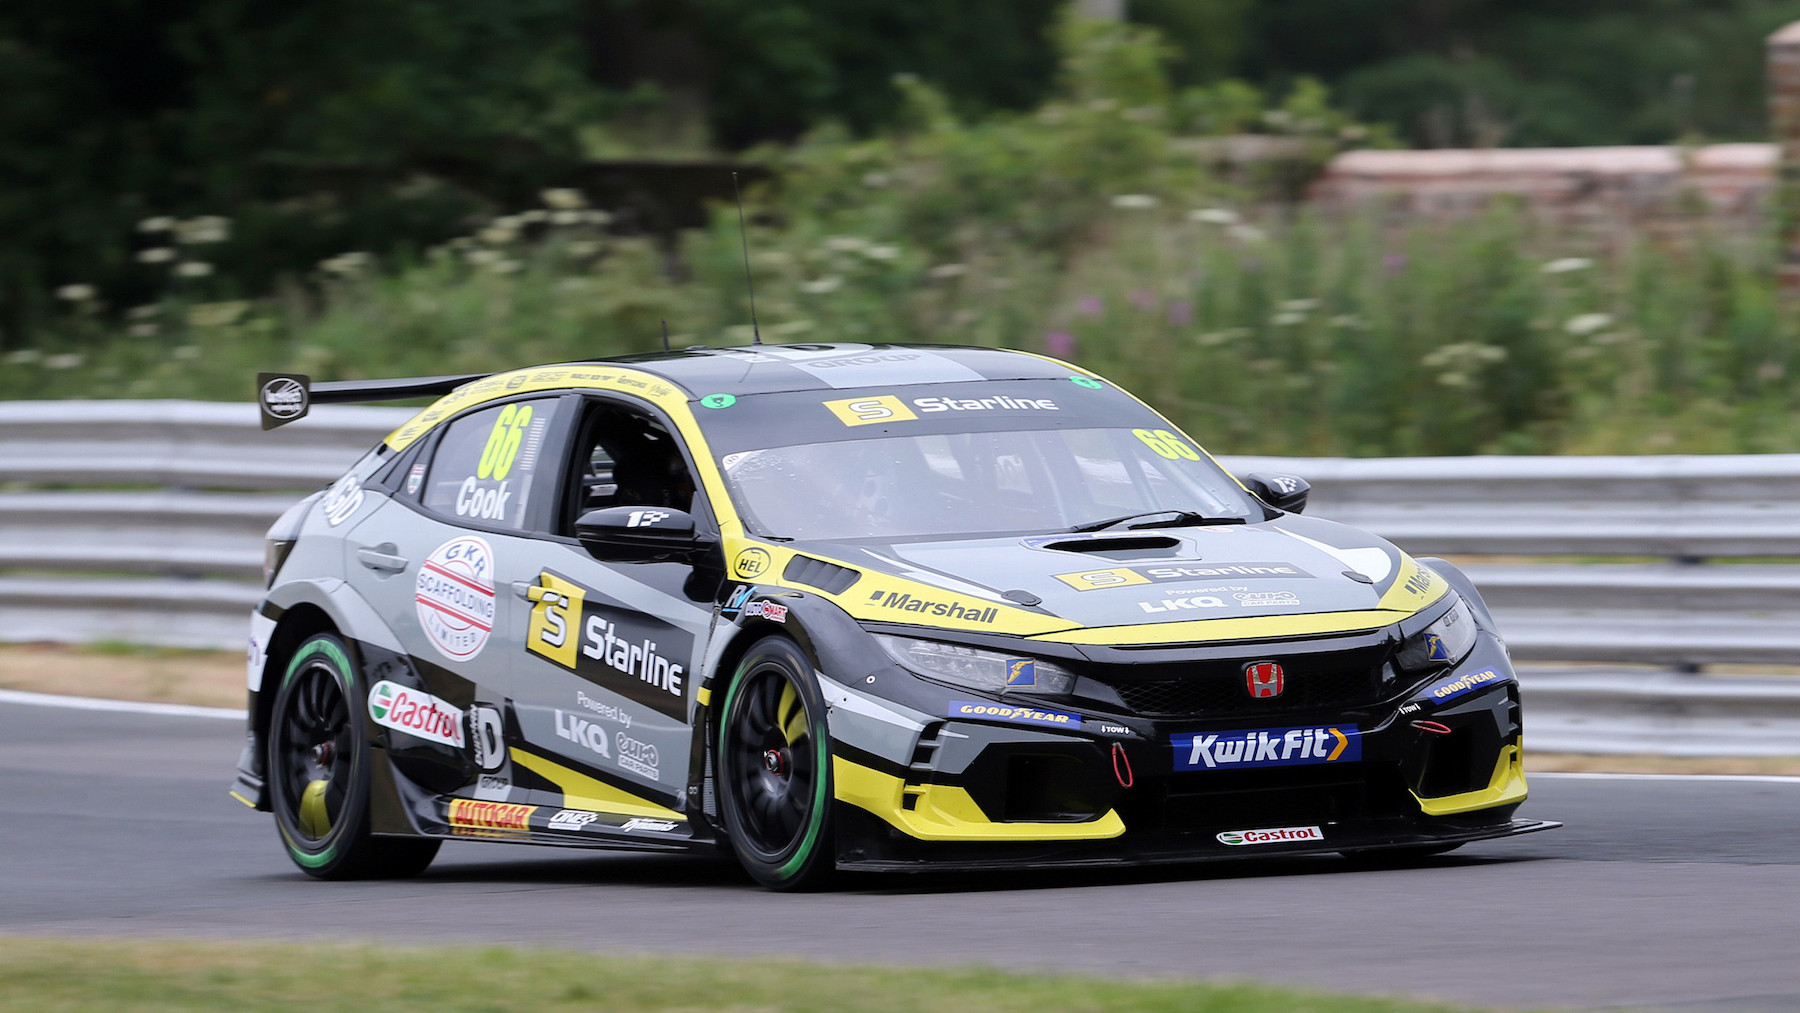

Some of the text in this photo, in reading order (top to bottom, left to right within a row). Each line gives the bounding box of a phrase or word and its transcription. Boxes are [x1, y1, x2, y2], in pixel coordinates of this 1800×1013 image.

[807, 353, 922, 369] GROUP
[913, 395, 1060, 413] Starline
[477, 403, 533, 481] 66
[1131, 428, 1201, 462] 66
[455, 476, 512, 520] Cook
[446, 544, 486, 576] GKR
[738, 558, 761, 573] HEL
[1149, 565, 1297, 579] Starline
[417, 573, 494, 618] SCAFFOLDING
[1139, 596, 1229, 614] LKQ
[1165, 586, 1228, 596] Powered
[881, 592, 999, 624] Marshall
[428, 613, 477, 648] LIMITED
[582, 614, 684, 697] Starline
[1433, 670, 1497, 699] GOODYEAR
[389, 692, 461, 741] Castrol
[577, 690, 633, 729] Powered by
[960, 704, 1070, 724] GOODYEAR
[1402, 704, 1417, 714] TOW
[555, 708, 612, 760] LKQ
[1106, 726, 1125, 734] TOW
[455, 801, 530, 830] AUTOCAR
[1243, 828, 1319, 843] Castrol
